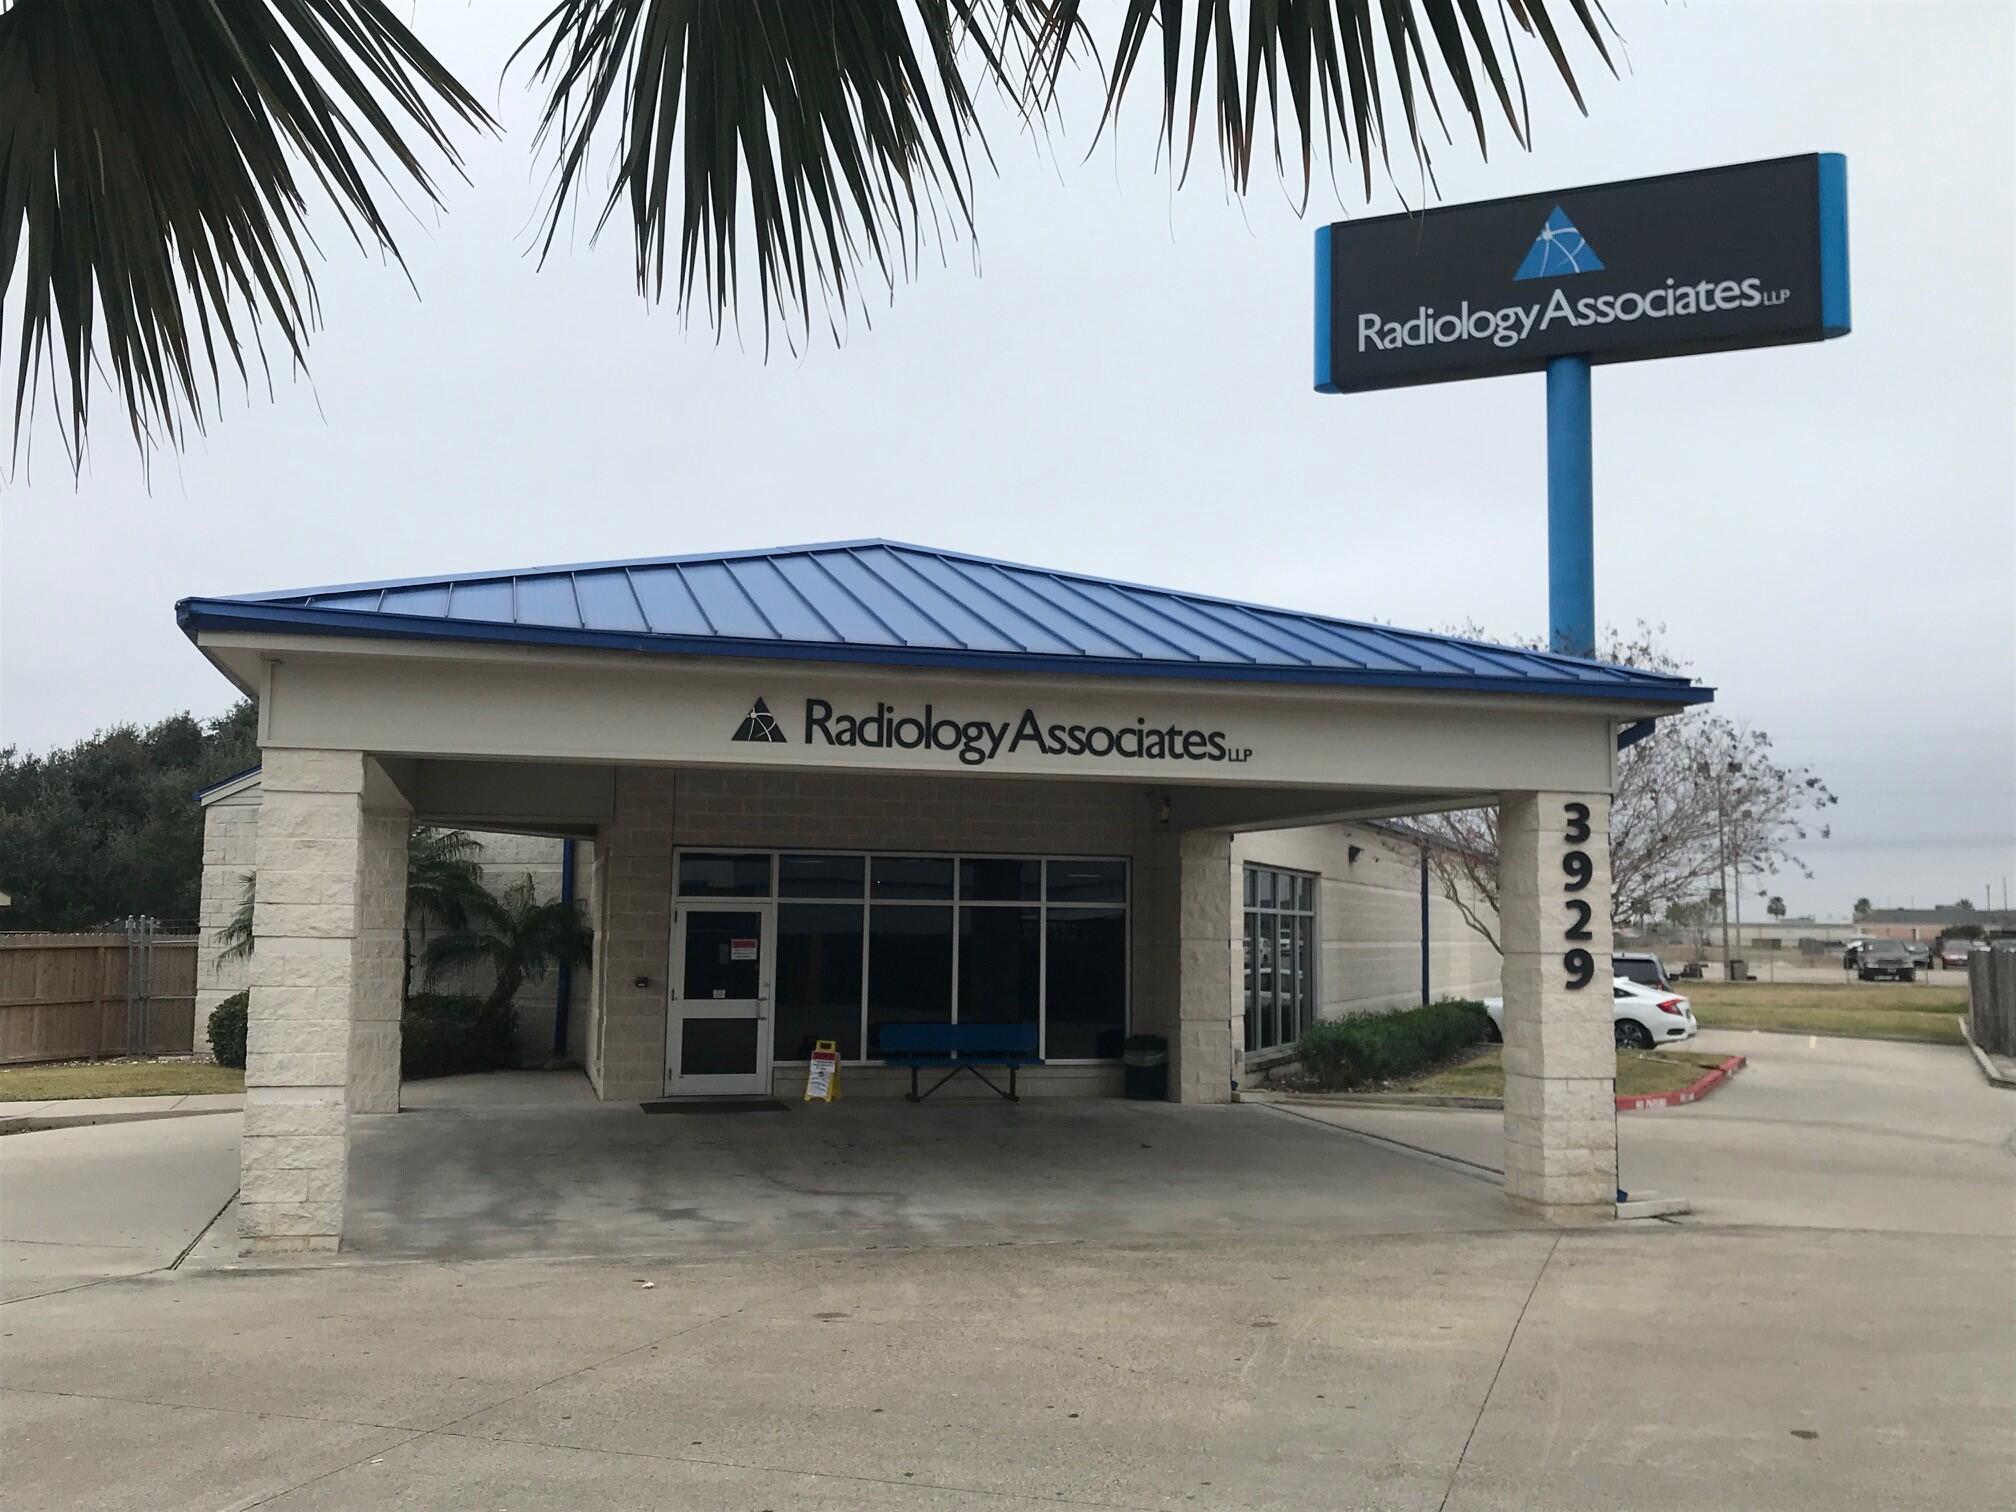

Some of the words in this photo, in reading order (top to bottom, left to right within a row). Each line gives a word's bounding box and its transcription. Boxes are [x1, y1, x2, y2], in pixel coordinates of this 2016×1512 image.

[1358, 300, 1541, 352] Radiology
[1539, 277, 1762, 331] Associates
[1763, 289, 1791, 306] LLP
[804, 698, 1010, 766] Radiology
[1007, 708, 1227, 761] Associates
[1228, 748, 1253, 763] LLP
[1562, 802, 1595, 990] 3929
